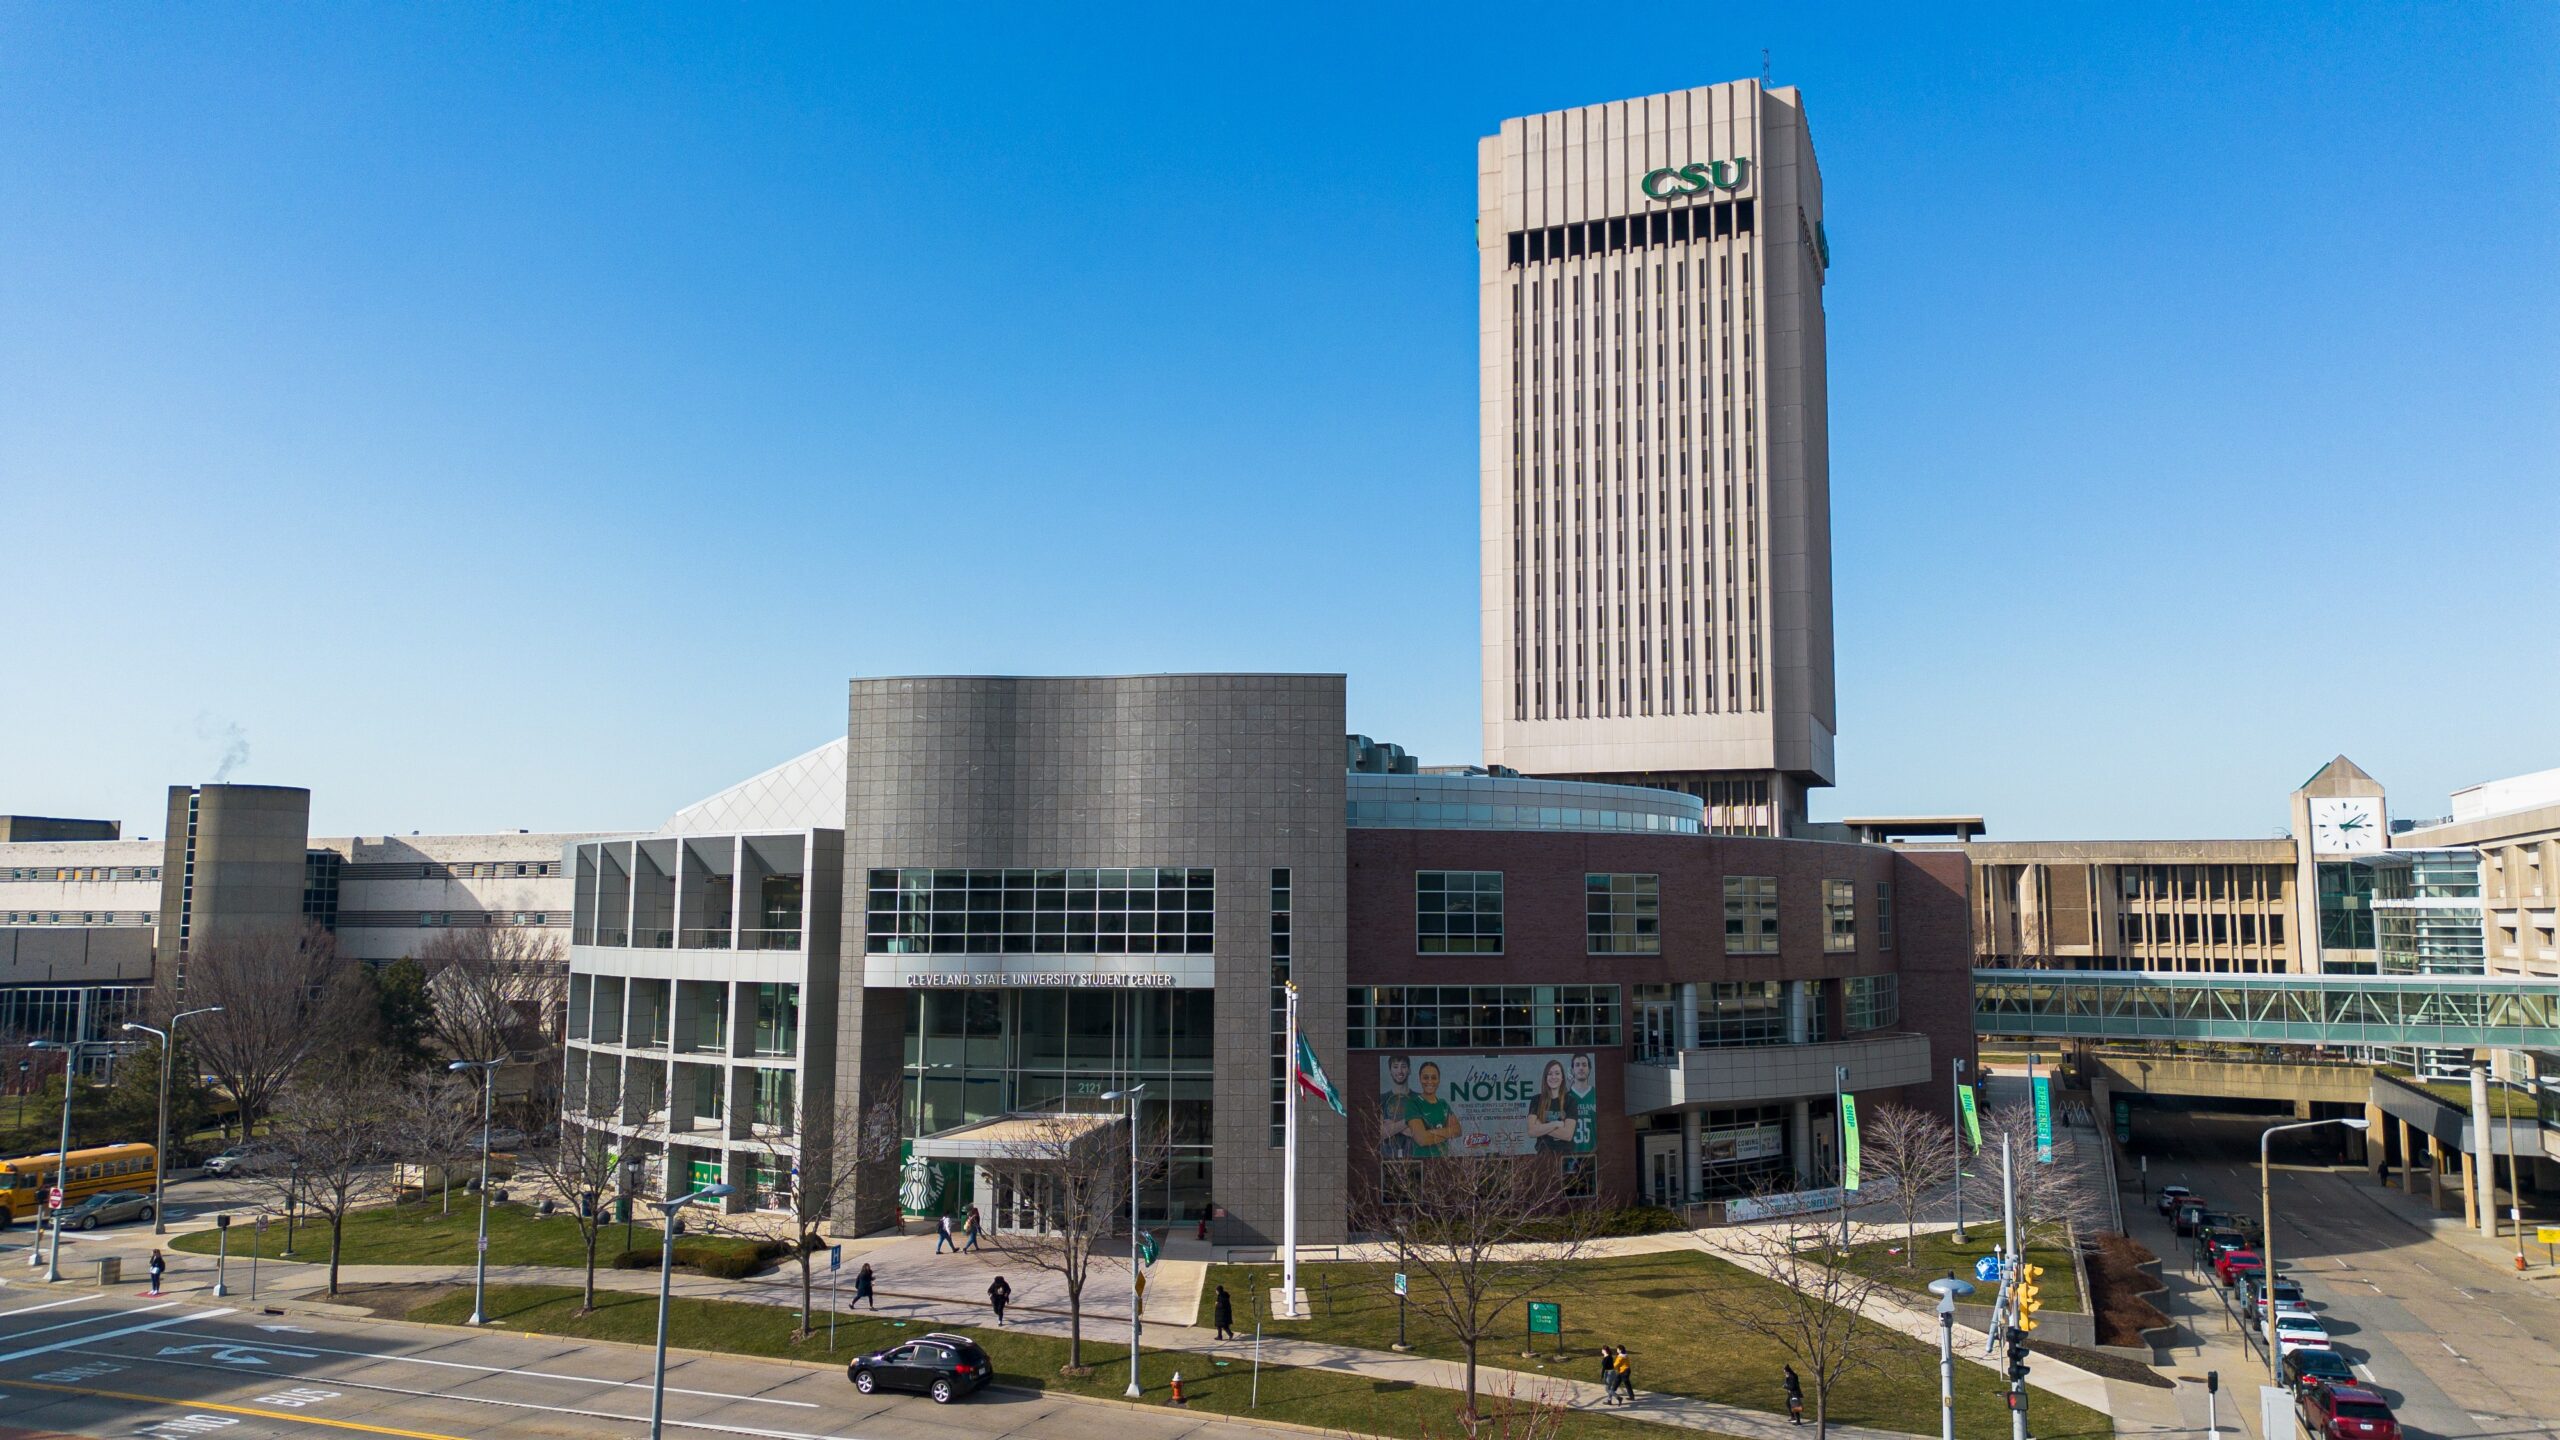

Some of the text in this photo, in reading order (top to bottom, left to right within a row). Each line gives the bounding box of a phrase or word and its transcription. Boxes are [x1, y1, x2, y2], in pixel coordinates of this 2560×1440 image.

[1641, 157, 1746, 198] CSU
[906, 974, 1173, 986] CLEVELAND STATE UNIVERSITY STUDENT CENTER
[1465, 1063, 1520, 1088] bring the
[1450, 1081, 1534, 1102] NOISE
[1962, 1093, 1974, 1113] DINE
[1845, 1104, 1855, 1128] SHOP
[1573, 1117, 1592, 1144] 35
[832, 1247, 840, 1263] H
[31, 1361, 132, 1383] ONLY
[252, 1387, 342, 1408] BUS
[133, 1414, 240, 1440] ONLY
